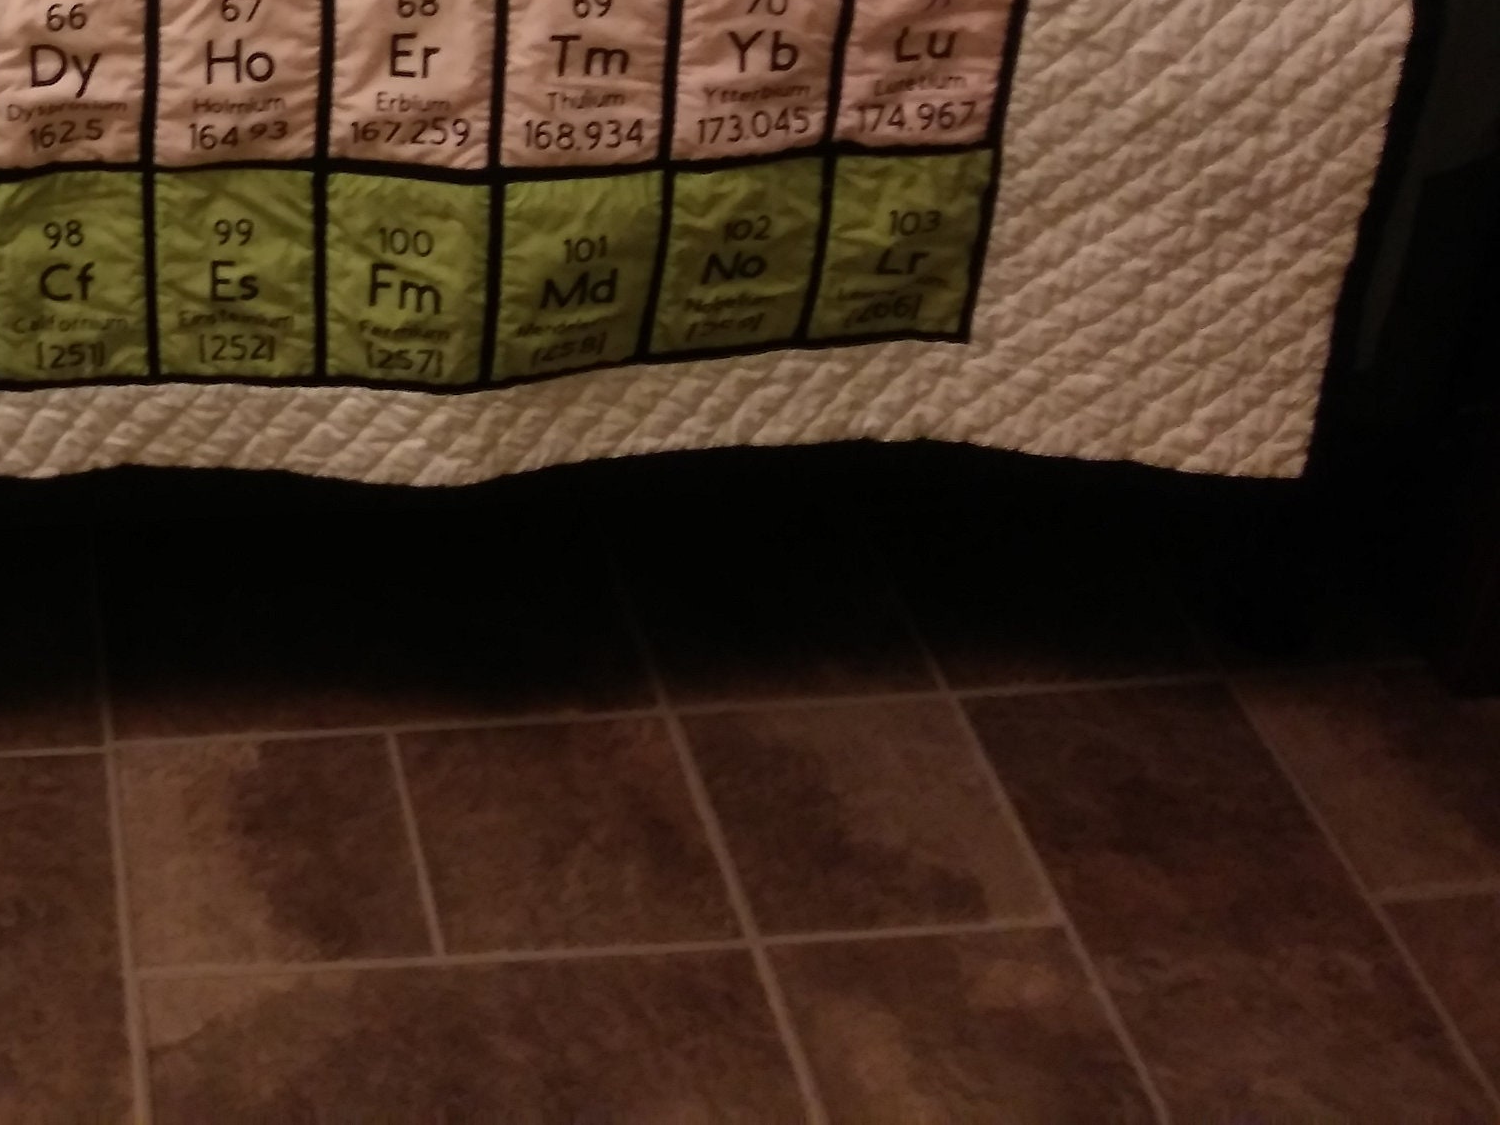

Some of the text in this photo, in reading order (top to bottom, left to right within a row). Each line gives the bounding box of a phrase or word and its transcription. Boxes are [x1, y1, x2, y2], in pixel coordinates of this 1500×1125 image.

[46, 3, 88, 32] 66
[205, 38, 276, 85] Ho
[389, 32, 441, 79] Er
[549, 34, 631, 77] Tm
[727, 29, 799, 73] Yb
[894, 27, 956, 63] Lu
[29, 44, 101, 98] Dy
[375, 91, 451, 113] Erbium
[858, 100, 978, 134] 174.967
[350, 117, 471, 147] 167.259
[524, 118, 645, 151] 168.934
[698, 106, 811, 145] 173.045
[43, 219, 84, 250] 98
[213, 218, 254, 246] 99
[724, 214, 772, 244] 102
[890, 210, 942, 236] 103
[379, 227, 435, 257] 100
[563, 225, 609, 264] 101
[701, 251, 768, 285] No
[877, 246, 931, 275] Lr
[39, 262, 96, 301] Cf
[210, 260, 259, 302] Es
[369, 262, 442, 315] Fm
[540, 268, 619, 309] Md
[200, 334, 275, 363] [252]
